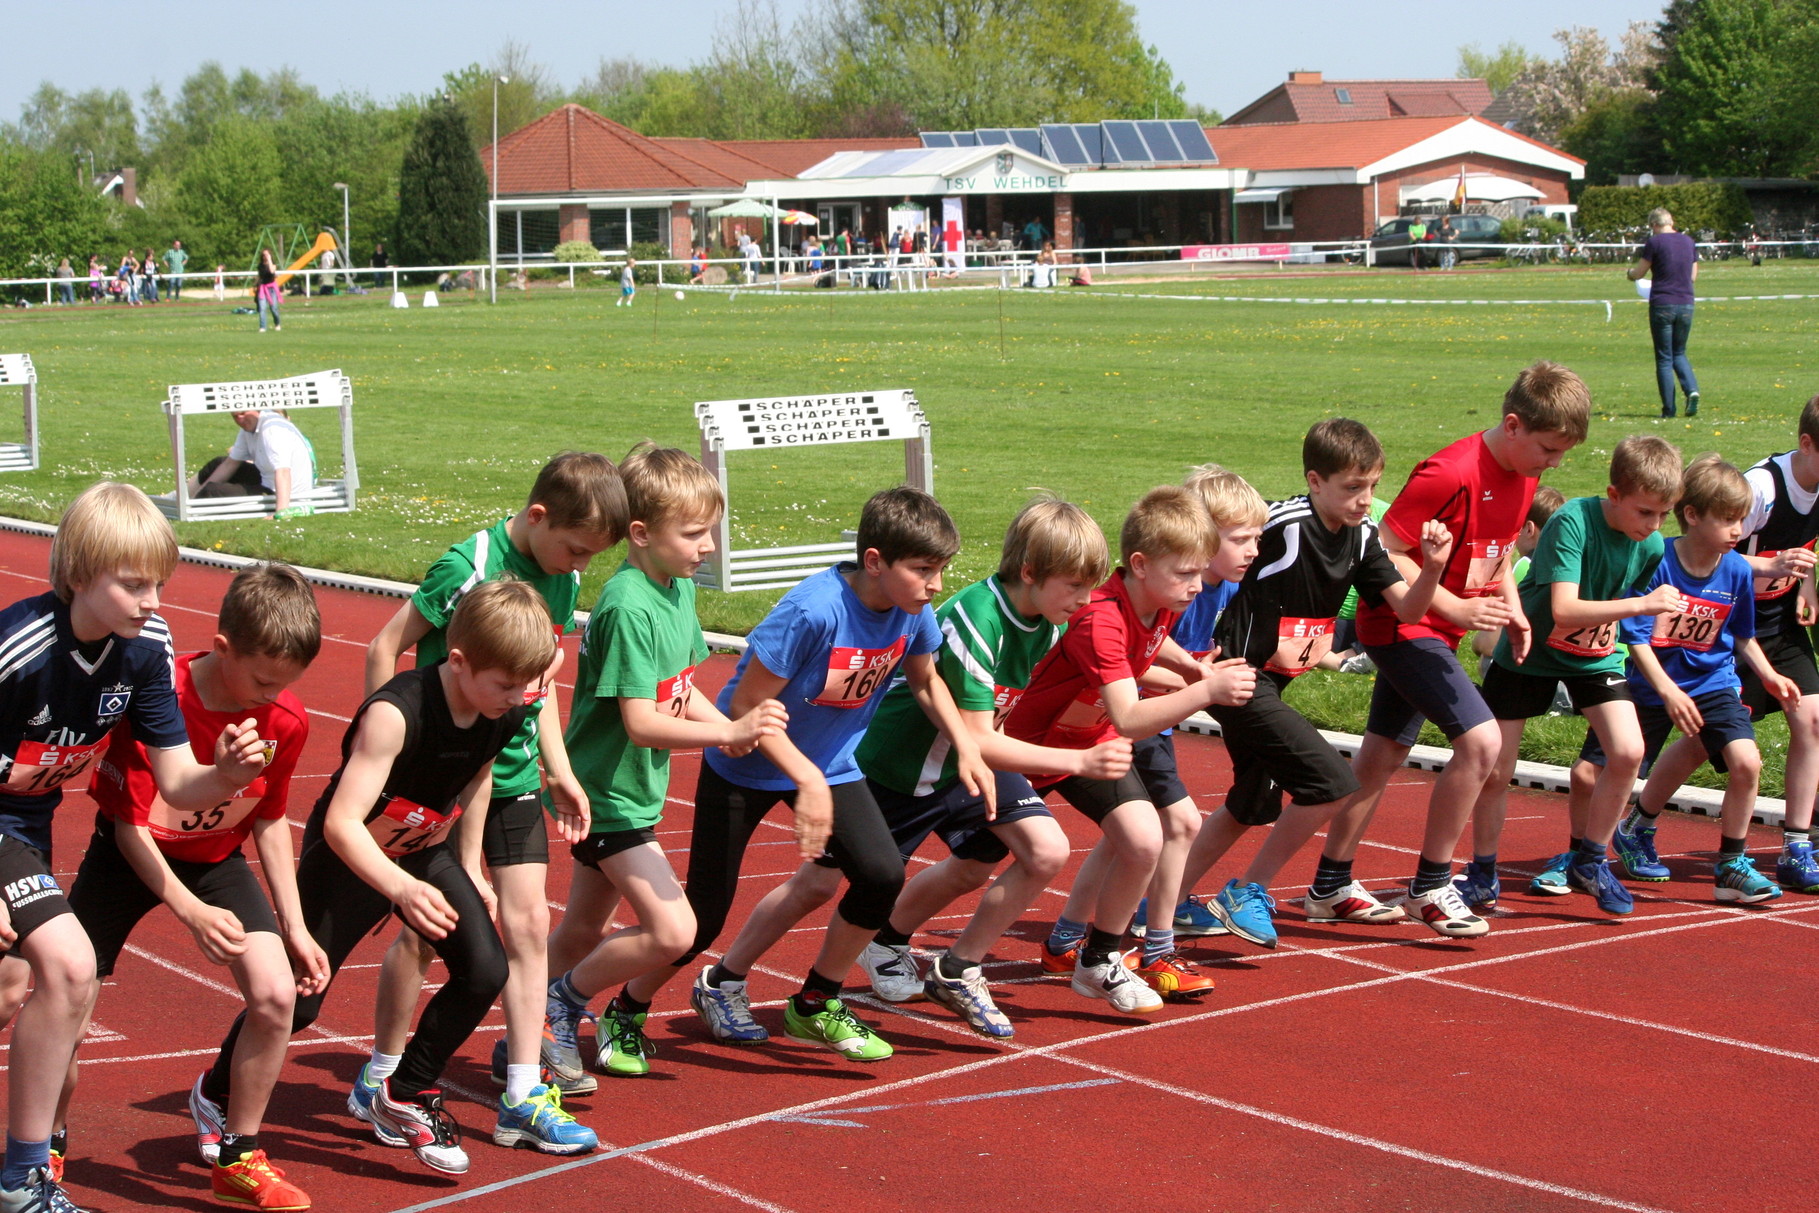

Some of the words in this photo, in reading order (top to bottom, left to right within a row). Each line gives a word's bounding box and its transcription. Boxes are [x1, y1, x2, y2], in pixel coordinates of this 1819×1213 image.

[944, 178, 976, 190] TSV
[994, 176, 1068, 189] WEHDEL
[1691, 603, 1720, 619] KSK
[1667, 613, 1713, 642] 130
[869, 648, 894, 668] KSK
[1298, 638, 1315, 666] 4
[842, 664, 888, 701] 160
[63, 745, 100, 765] KSK
[27, 757, 92, 791] 164
[4, 875, 41, 902] HSV
